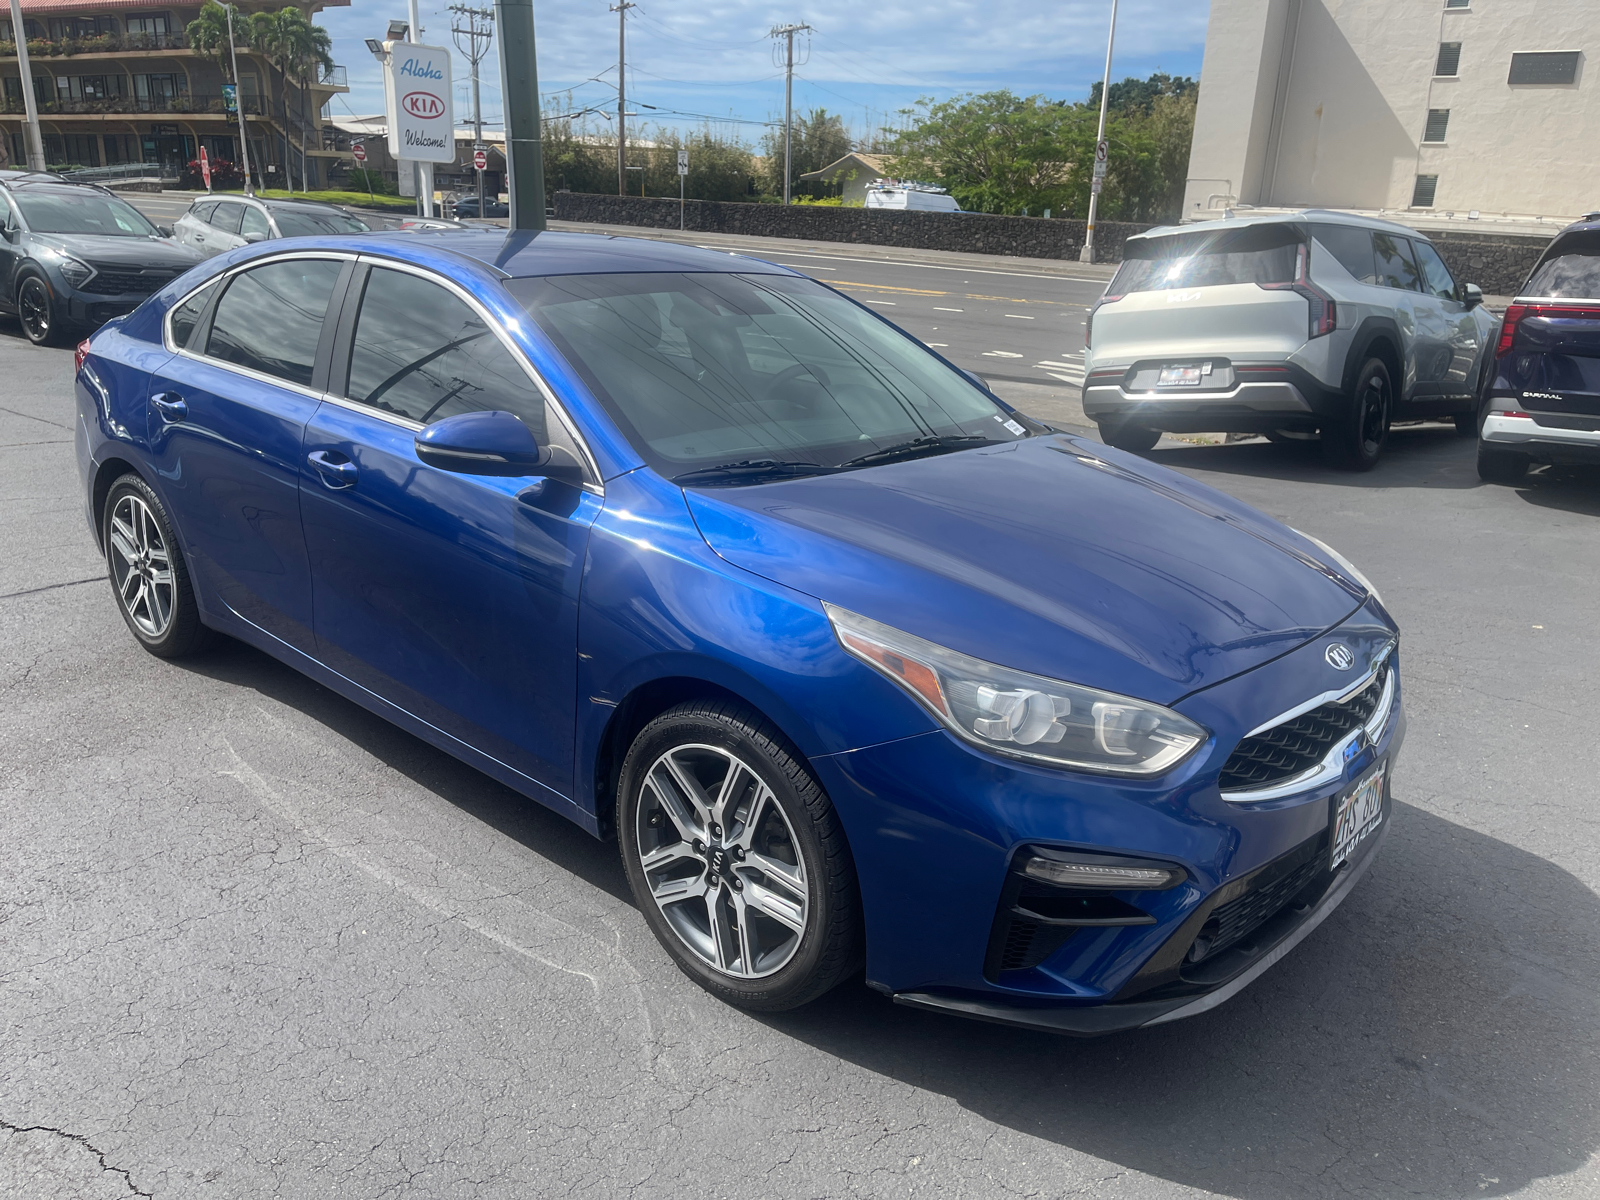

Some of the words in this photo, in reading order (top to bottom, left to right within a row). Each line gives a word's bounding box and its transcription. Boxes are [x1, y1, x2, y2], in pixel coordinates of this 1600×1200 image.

[400, 58, 443, 80] Aloha
[404, 128, 447, 149] Welcome!
[1329, 645, 1352, 668] KIA
[712, 851, 724, 872] KIA
